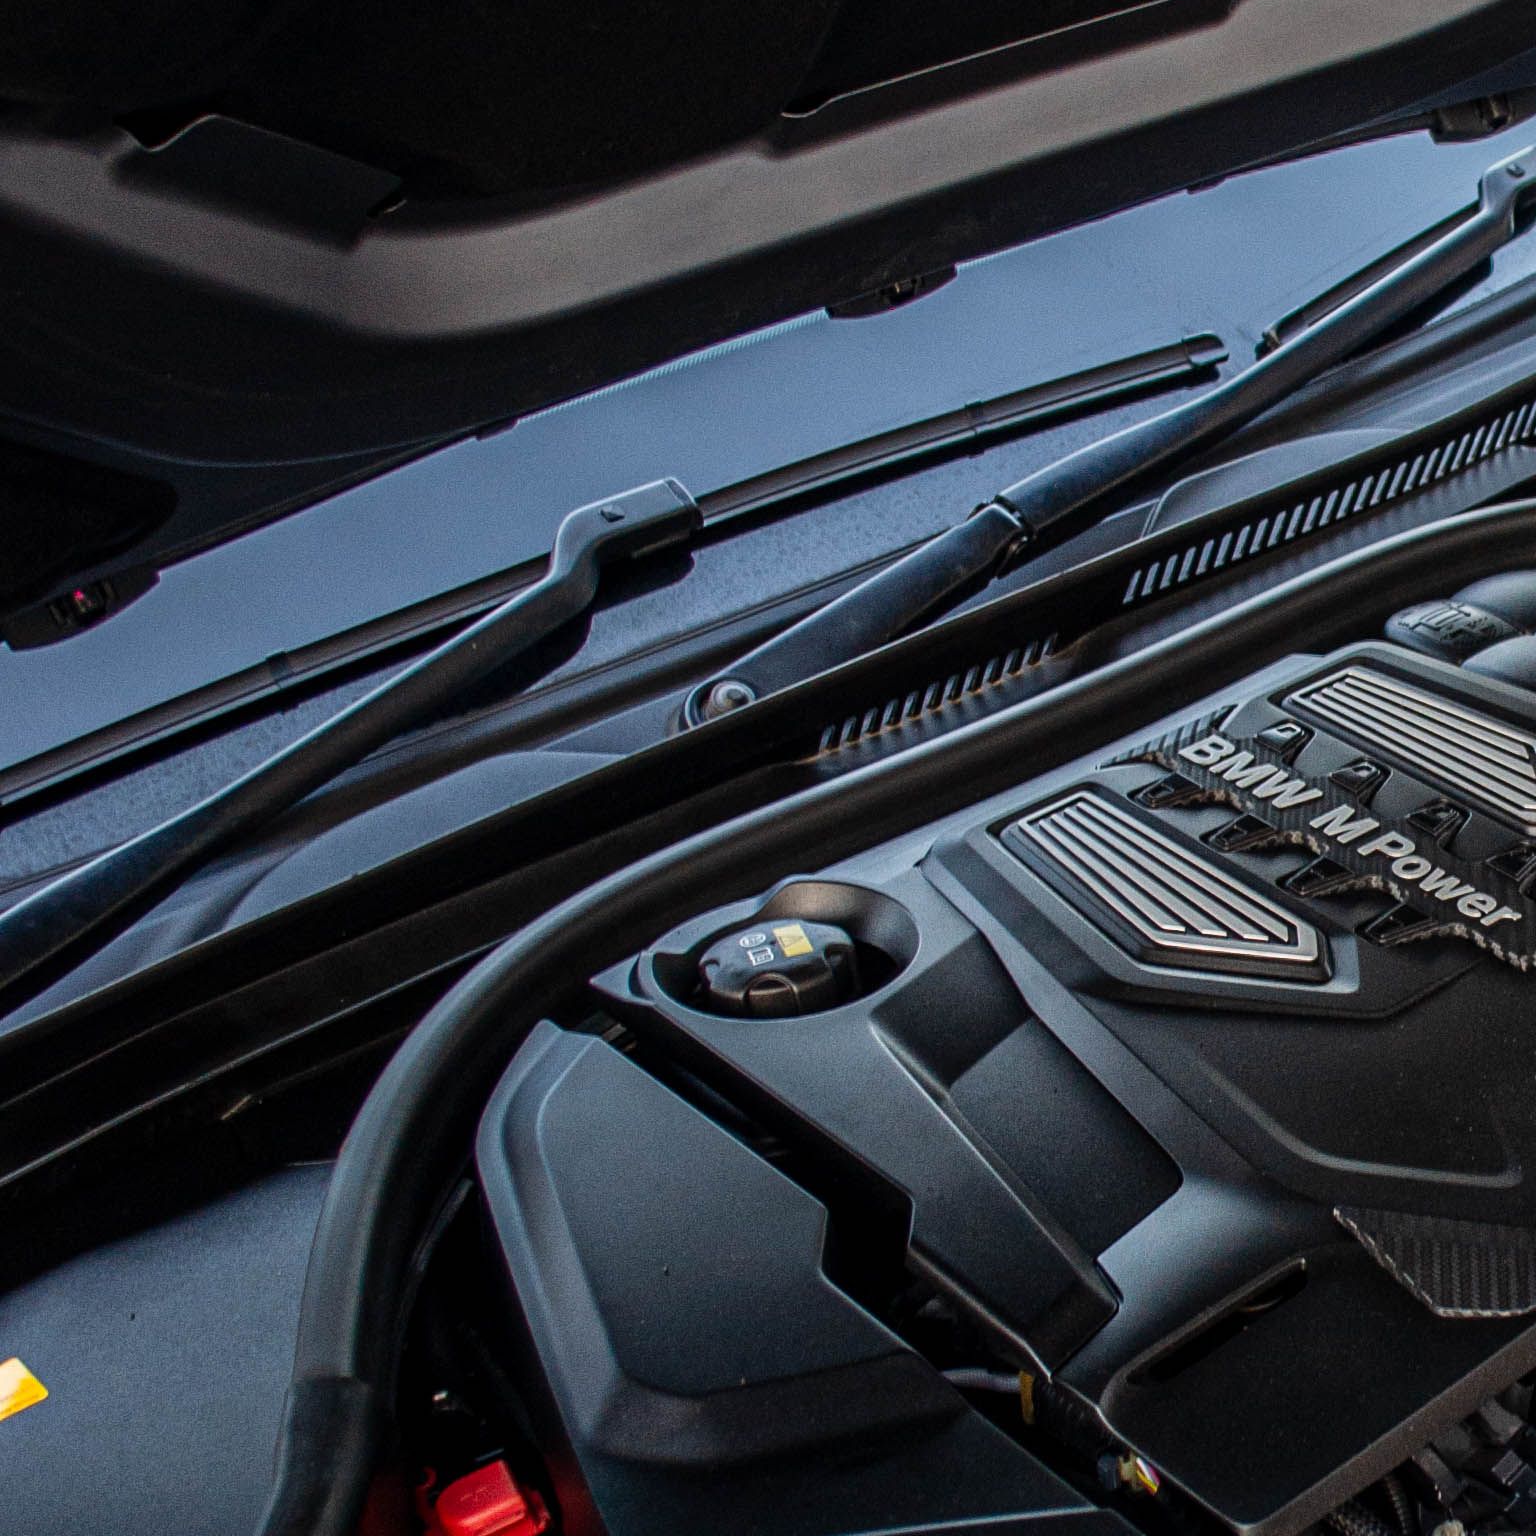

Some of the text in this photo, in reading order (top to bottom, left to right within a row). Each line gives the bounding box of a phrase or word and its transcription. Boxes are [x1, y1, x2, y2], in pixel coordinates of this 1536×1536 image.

[1178, 734, 1522, 927] BMW M Power
